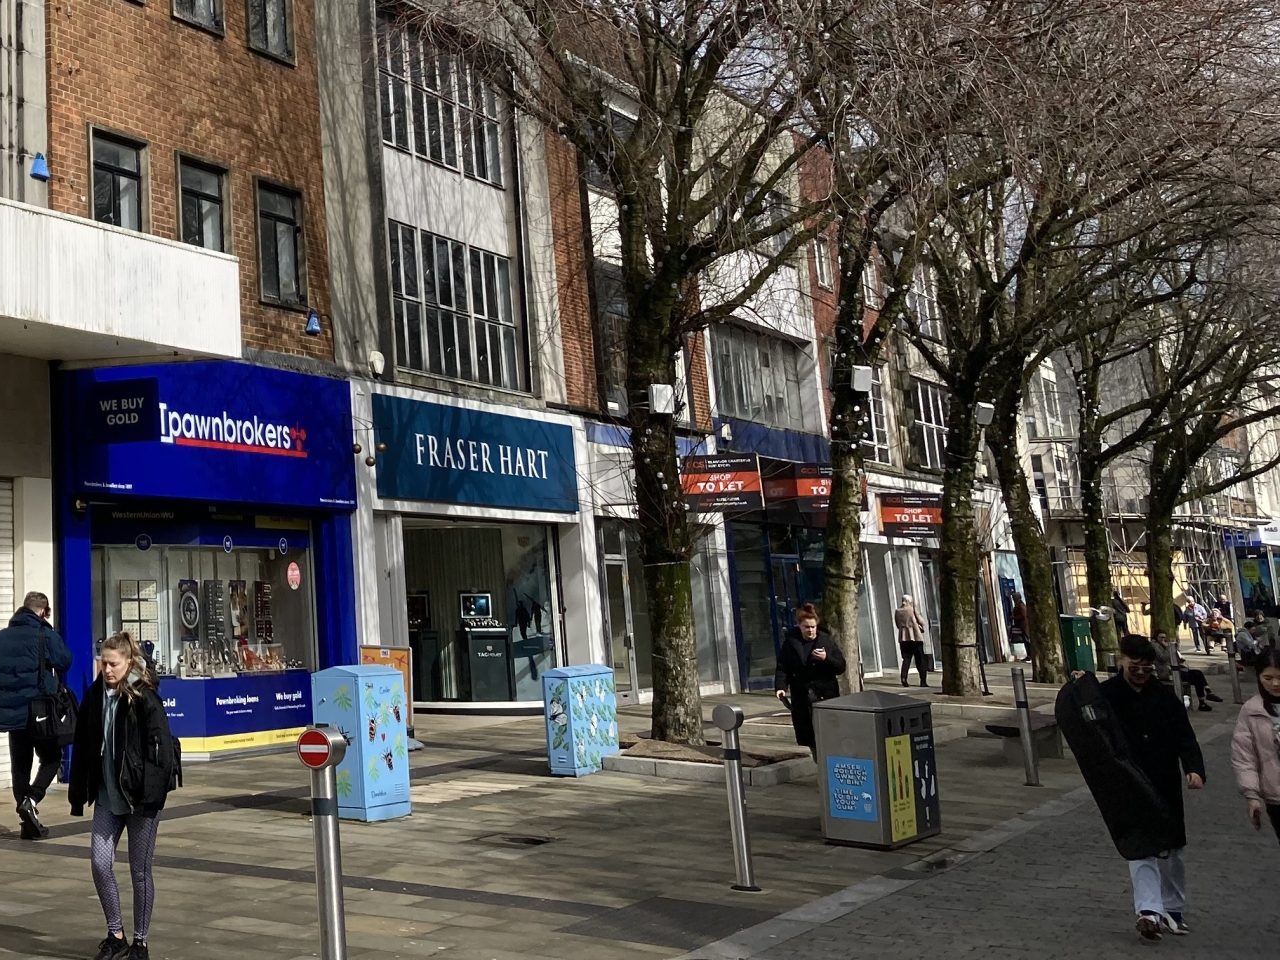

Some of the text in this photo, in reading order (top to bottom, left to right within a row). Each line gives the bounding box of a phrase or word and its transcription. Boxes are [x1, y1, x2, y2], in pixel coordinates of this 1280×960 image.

[99, 397, 144, 411] WE BUY
[106, 413, 139, 425] GOLD
[168, 411, 291, 449] pawnbrokers
[414, 433, 549, 479] FRASER HART
[709, 473, 731, 481] SHOP
[697, 481, 744, 491] TO LET
[811, 486, 827, 495] TO
[894, 514, 933, 523] TO LET
[216, 694, 259, 706] Pawnbroking loans
[275, 690, 302, 702] We buy gold
[163, 698, 176, 707] old
